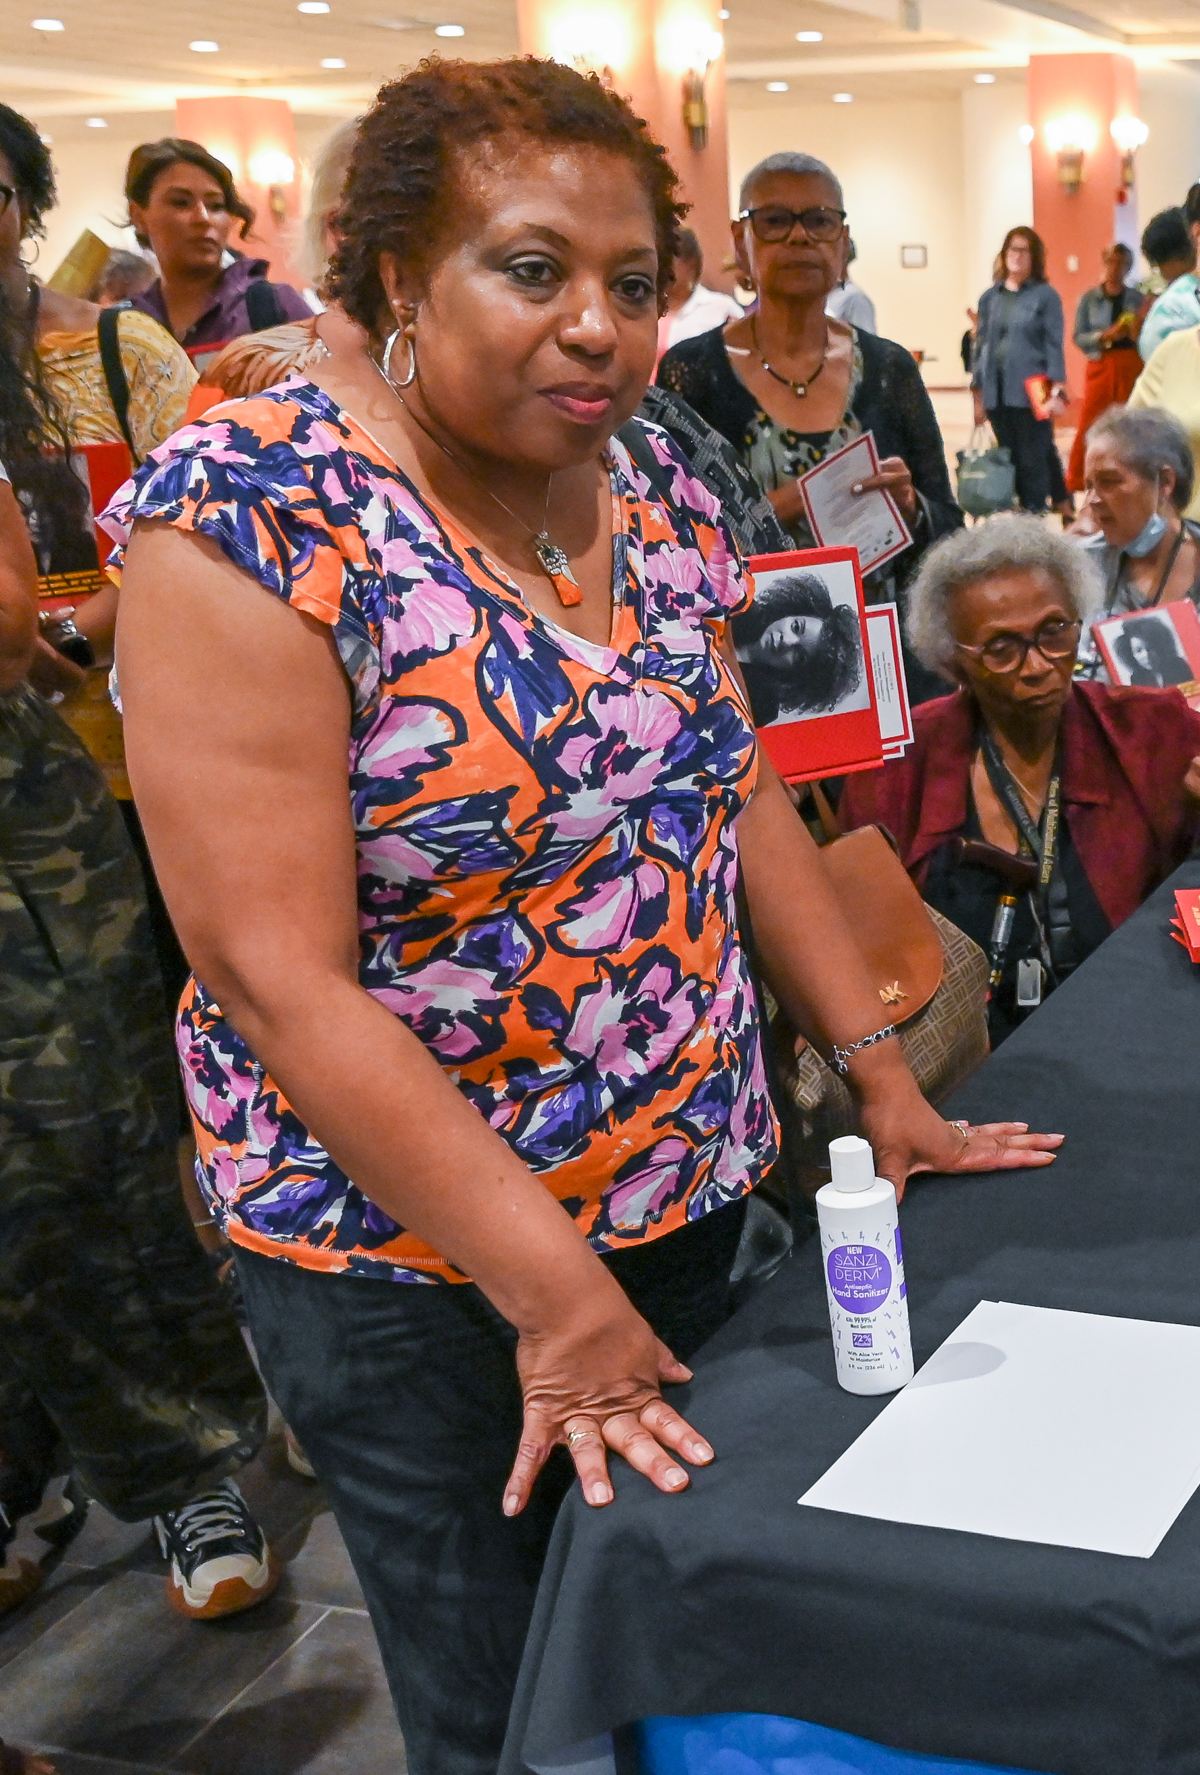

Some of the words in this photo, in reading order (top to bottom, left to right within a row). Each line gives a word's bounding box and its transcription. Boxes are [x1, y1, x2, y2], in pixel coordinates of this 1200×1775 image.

[847, 1246, 863, 1255] NEW
[834, 1253, 878, 1267] SANZI
[832, 1286, 851, 1298] Hand
[853, 1288, 889, 1298] Sanitizer
[844, 1283, 873, 1291] Antiseptic
